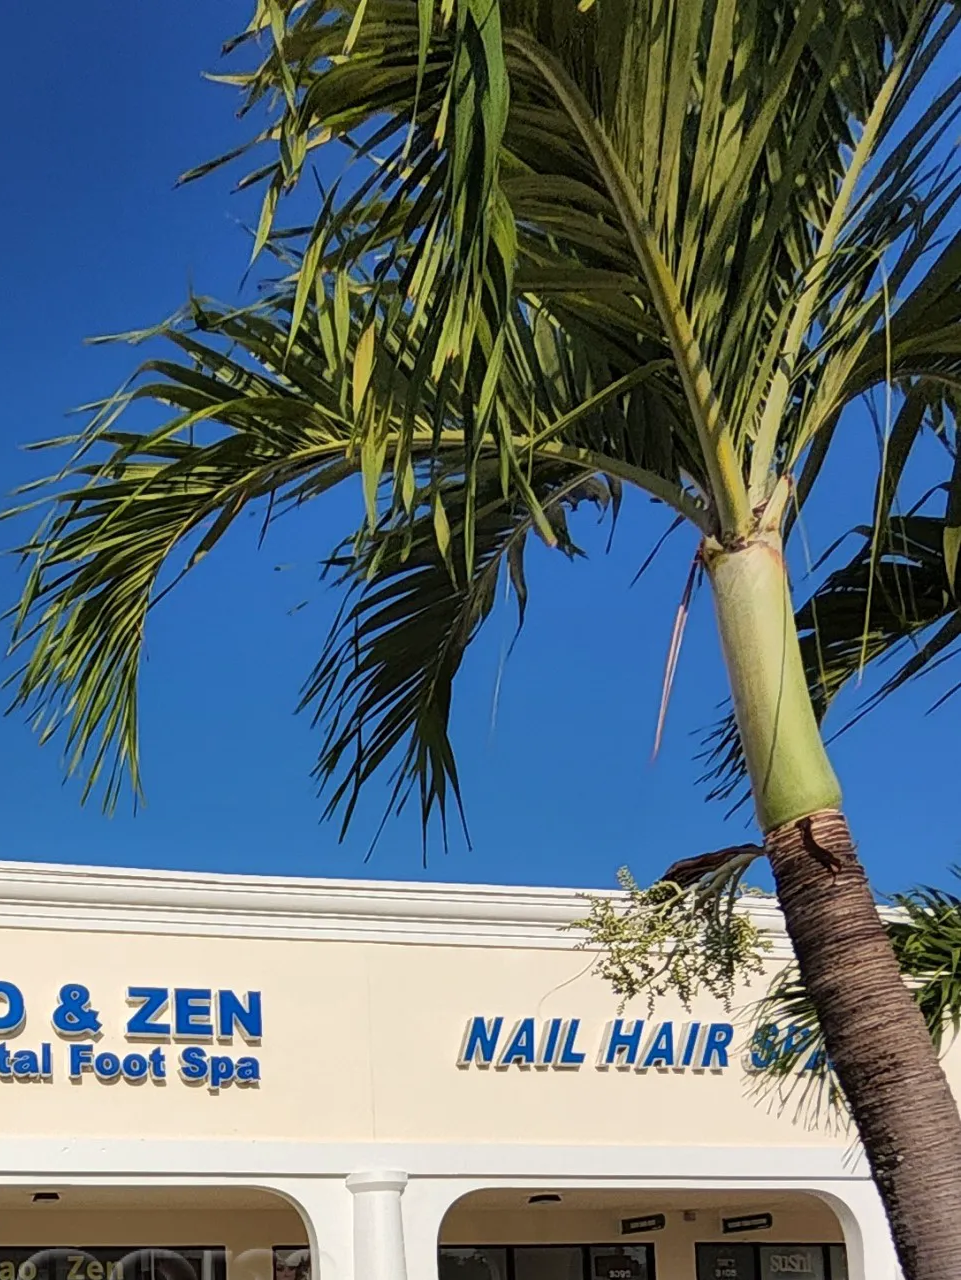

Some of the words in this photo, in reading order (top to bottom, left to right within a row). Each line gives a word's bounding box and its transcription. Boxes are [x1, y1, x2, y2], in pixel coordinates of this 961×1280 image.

[52, 983, 103, 1035] &
[125, 986, 263, 1039] ZEN
[68, 1044, 167, 1080] Foot
[180, 1047, 261, 1090] Spa
[458, 1017, 587, 1068] NAIL
[596, 1019, 734, 1071] HAIR
[66, 1255, 125, 1280] Zen
